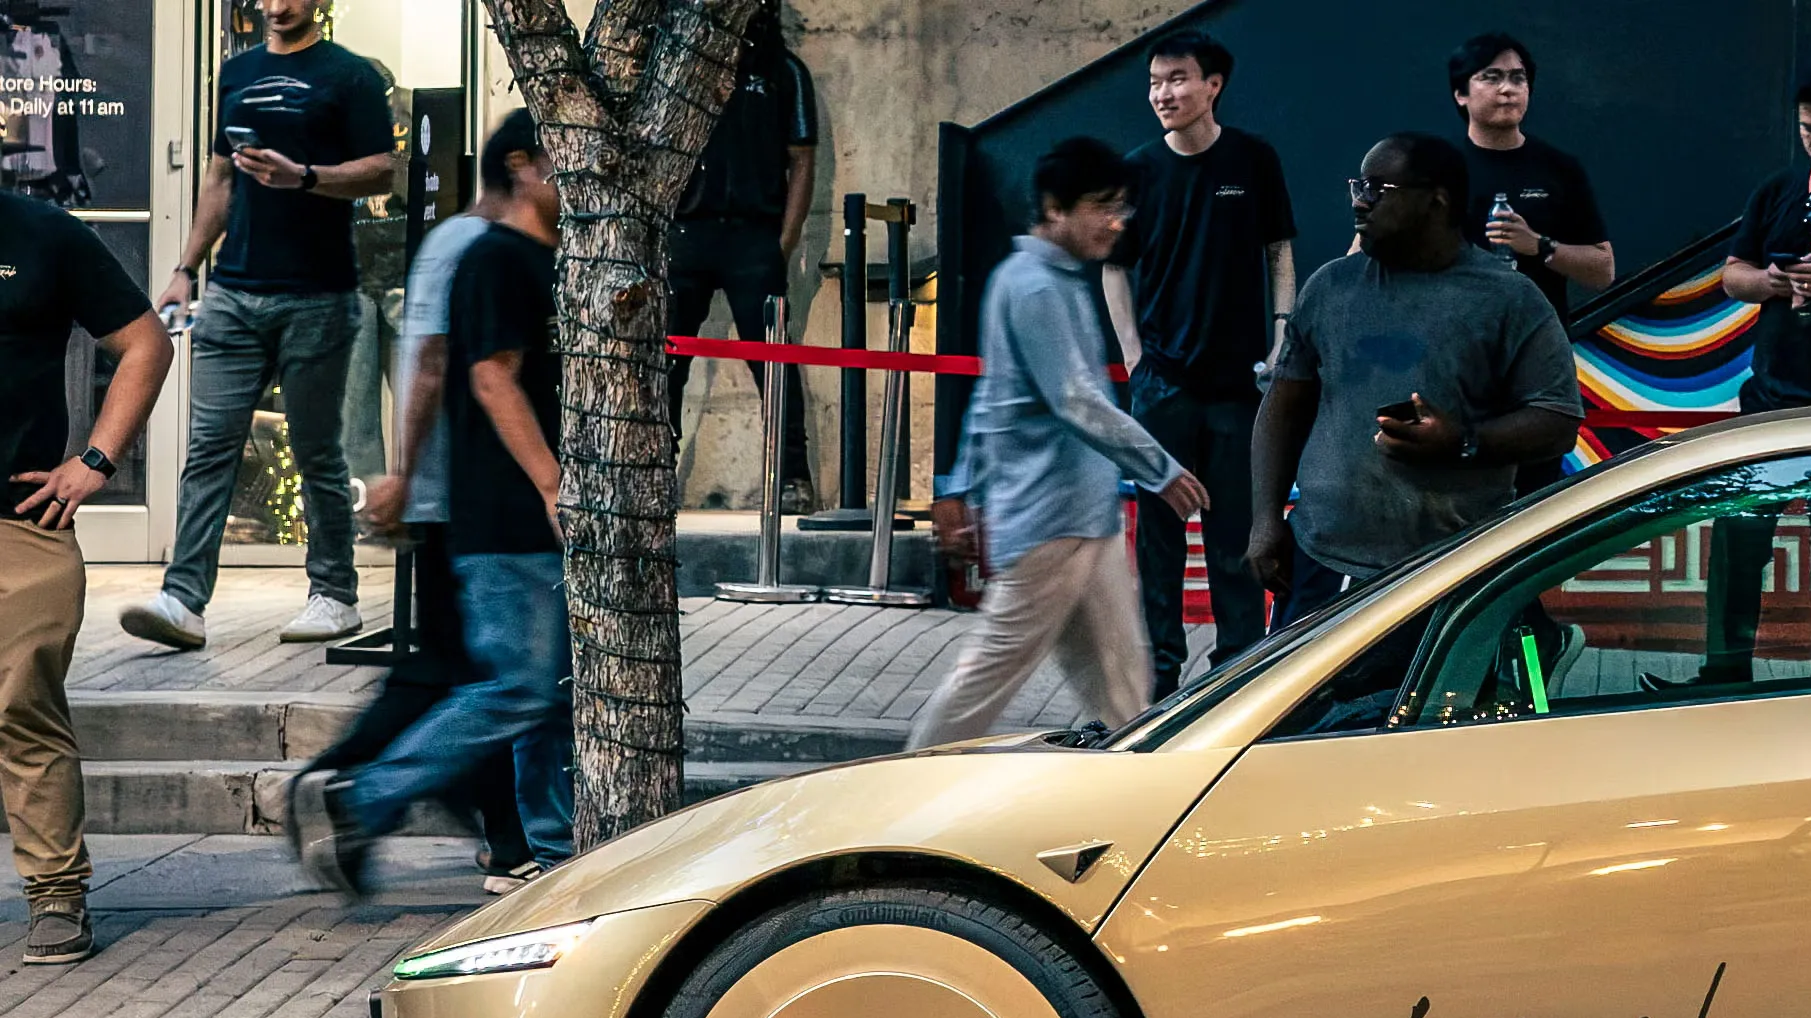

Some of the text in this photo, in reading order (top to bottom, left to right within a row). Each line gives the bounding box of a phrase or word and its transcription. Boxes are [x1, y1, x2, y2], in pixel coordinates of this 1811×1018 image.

[0, 75, 97, 92] tore Hours:
[10, 97, 53, 118] Daily
[57, 98, 75, 115] at
[79, 98, 94, 115] 11
[97, 101, 124, 116] am
